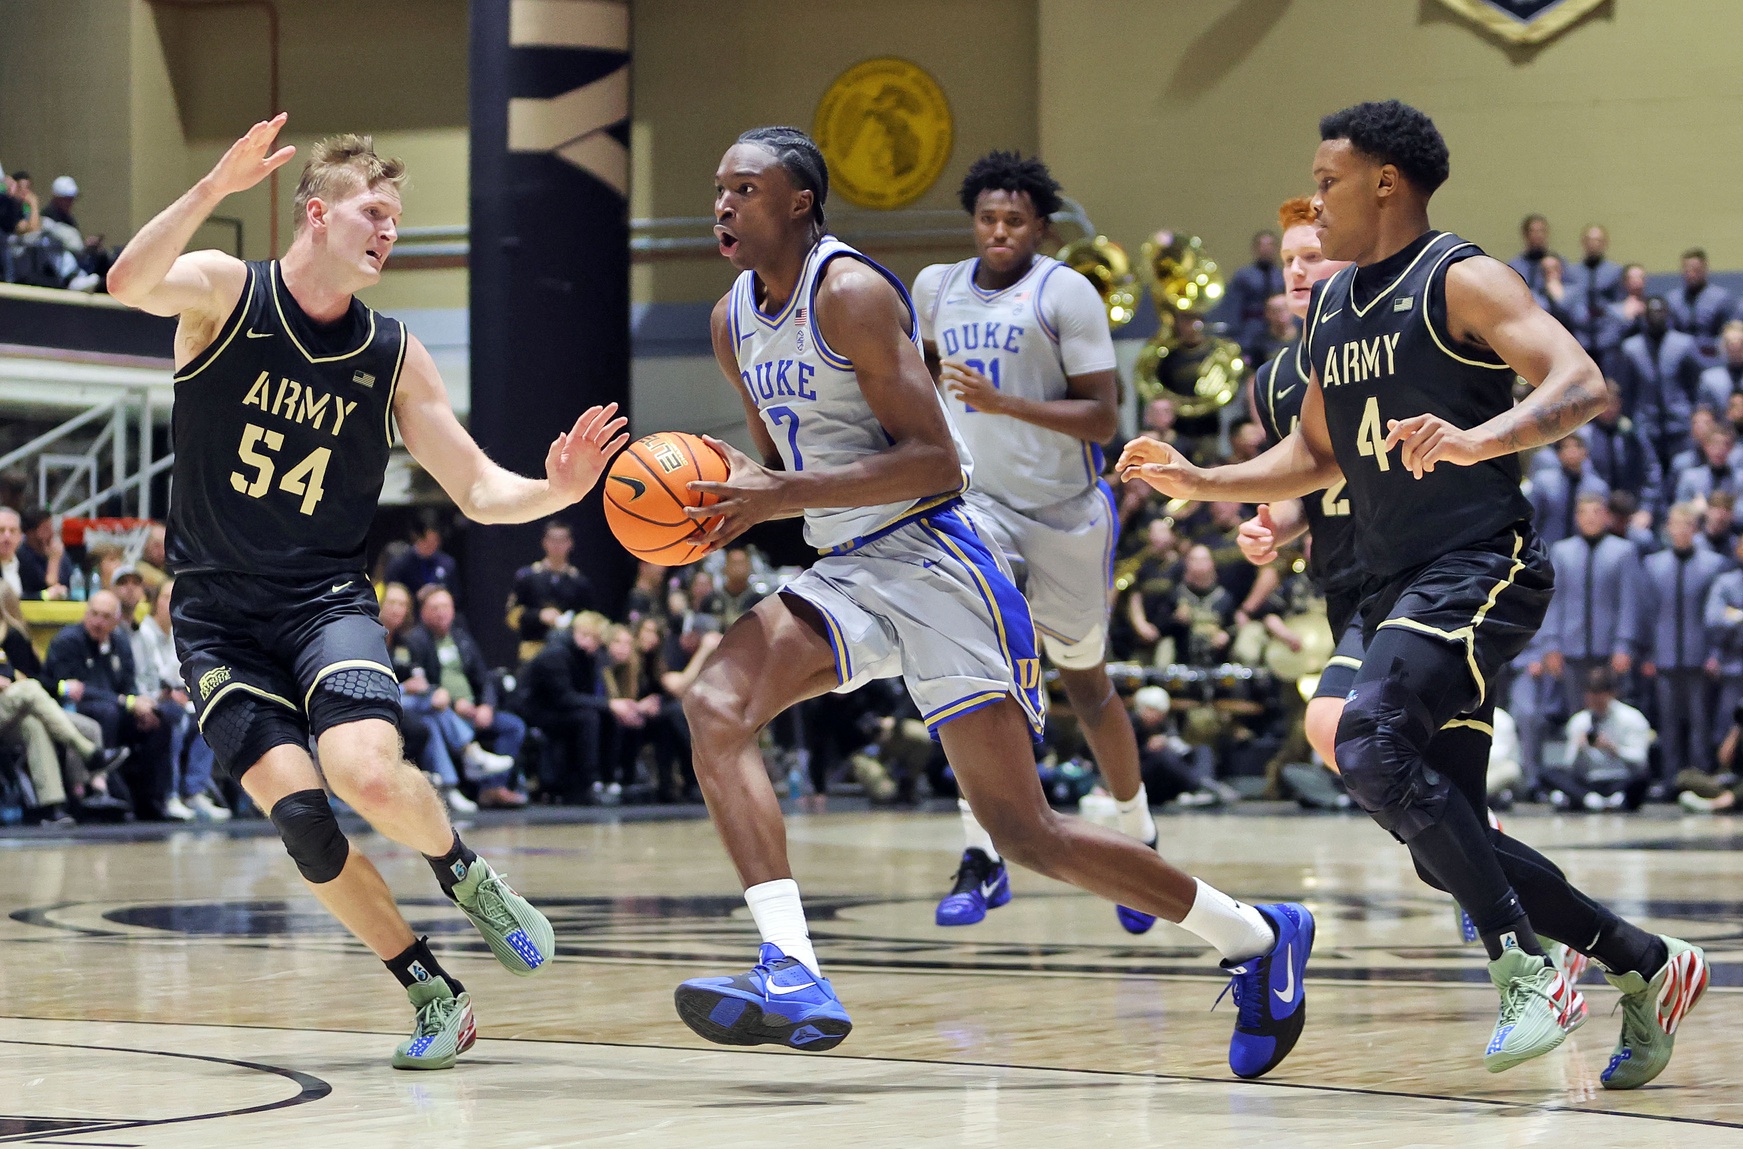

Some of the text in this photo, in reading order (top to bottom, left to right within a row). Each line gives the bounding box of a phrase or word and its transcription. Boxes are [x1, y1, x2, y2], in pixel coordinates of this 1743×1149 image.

[942, 321, 1025, 356] DUKE
[1323, 331, 1401, 388] ARMY
[242, 370, 358, 436] ARMY
[1356, 396, 1391, 472] 4
[229, 422, 333, 516] 54
[767, 406, 804, 471] 7
